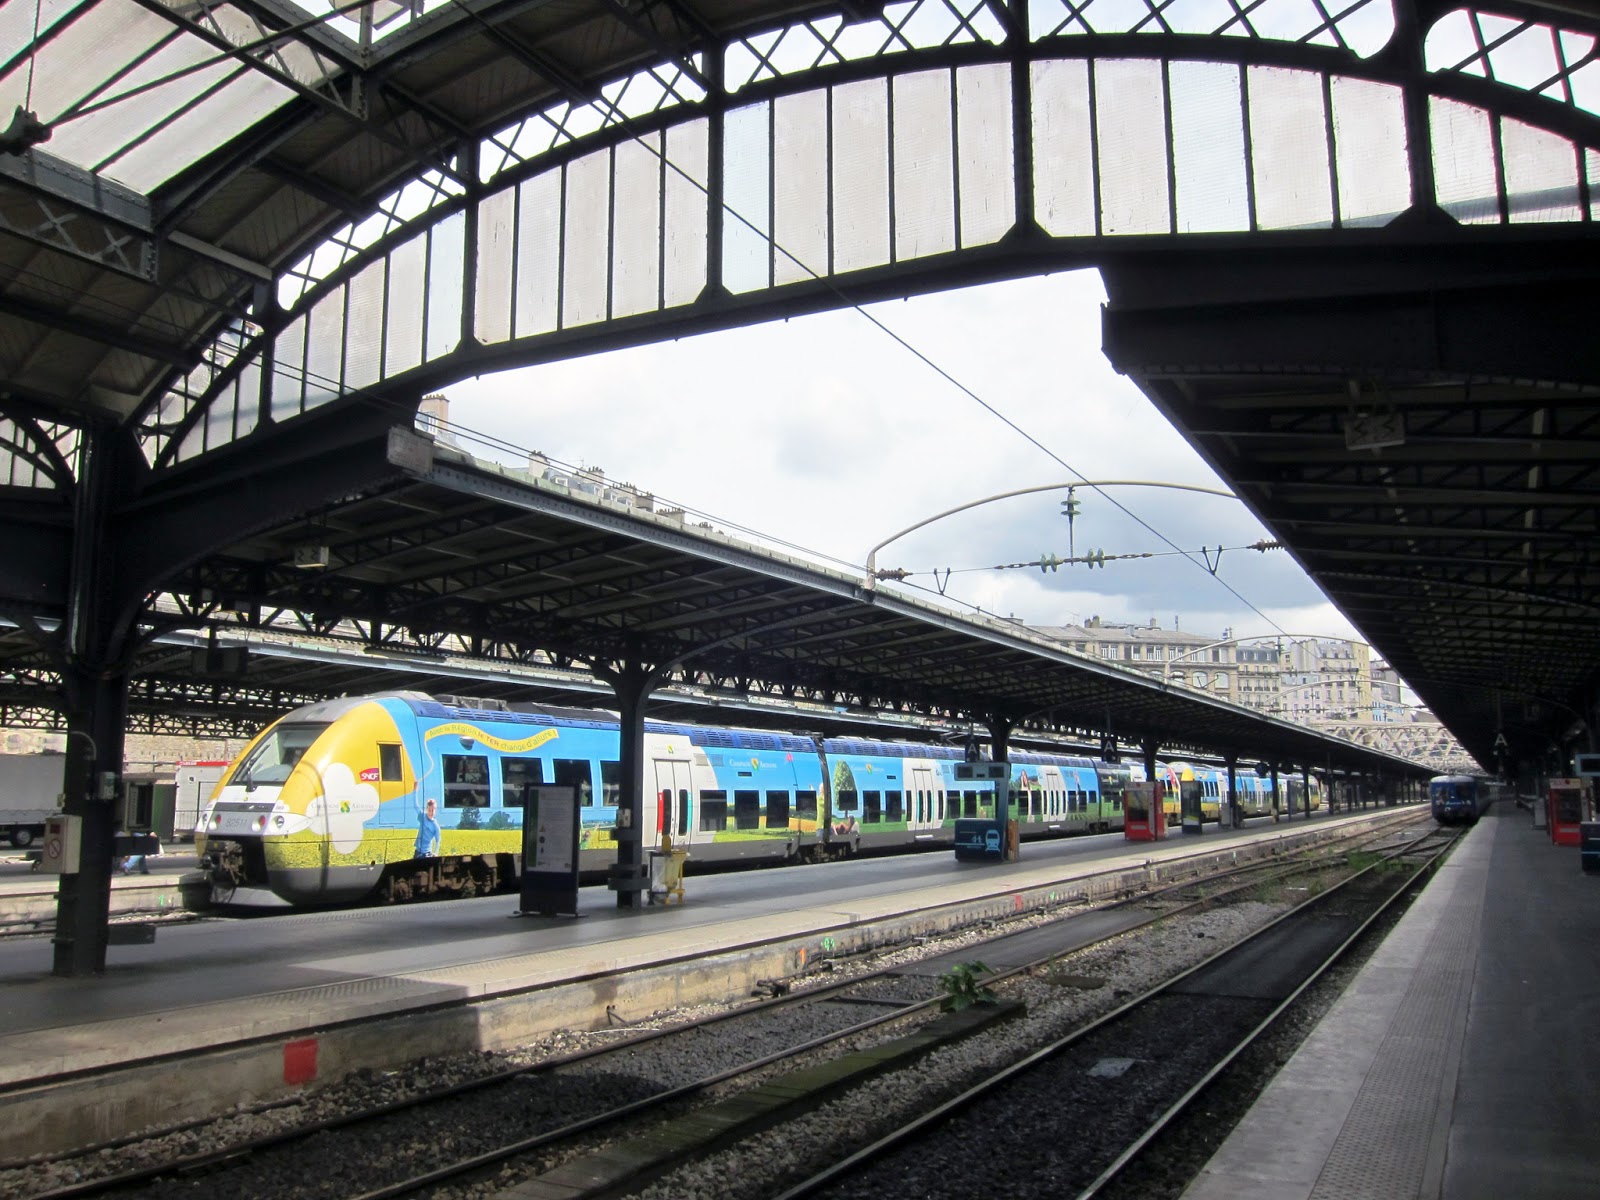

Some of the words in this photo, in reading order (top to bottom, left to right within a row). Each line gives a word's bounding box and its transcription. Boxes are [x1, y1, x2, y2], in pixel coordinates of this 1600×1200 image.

[485, 736, 500, 747] TER
[500, 743, 525, 752] change
[1494, 732, 1508, 747] A
[967, 743, 977, 754] A
[1104, 740, 1115, 752] A
[361, 772, 379, 780] SNCF
